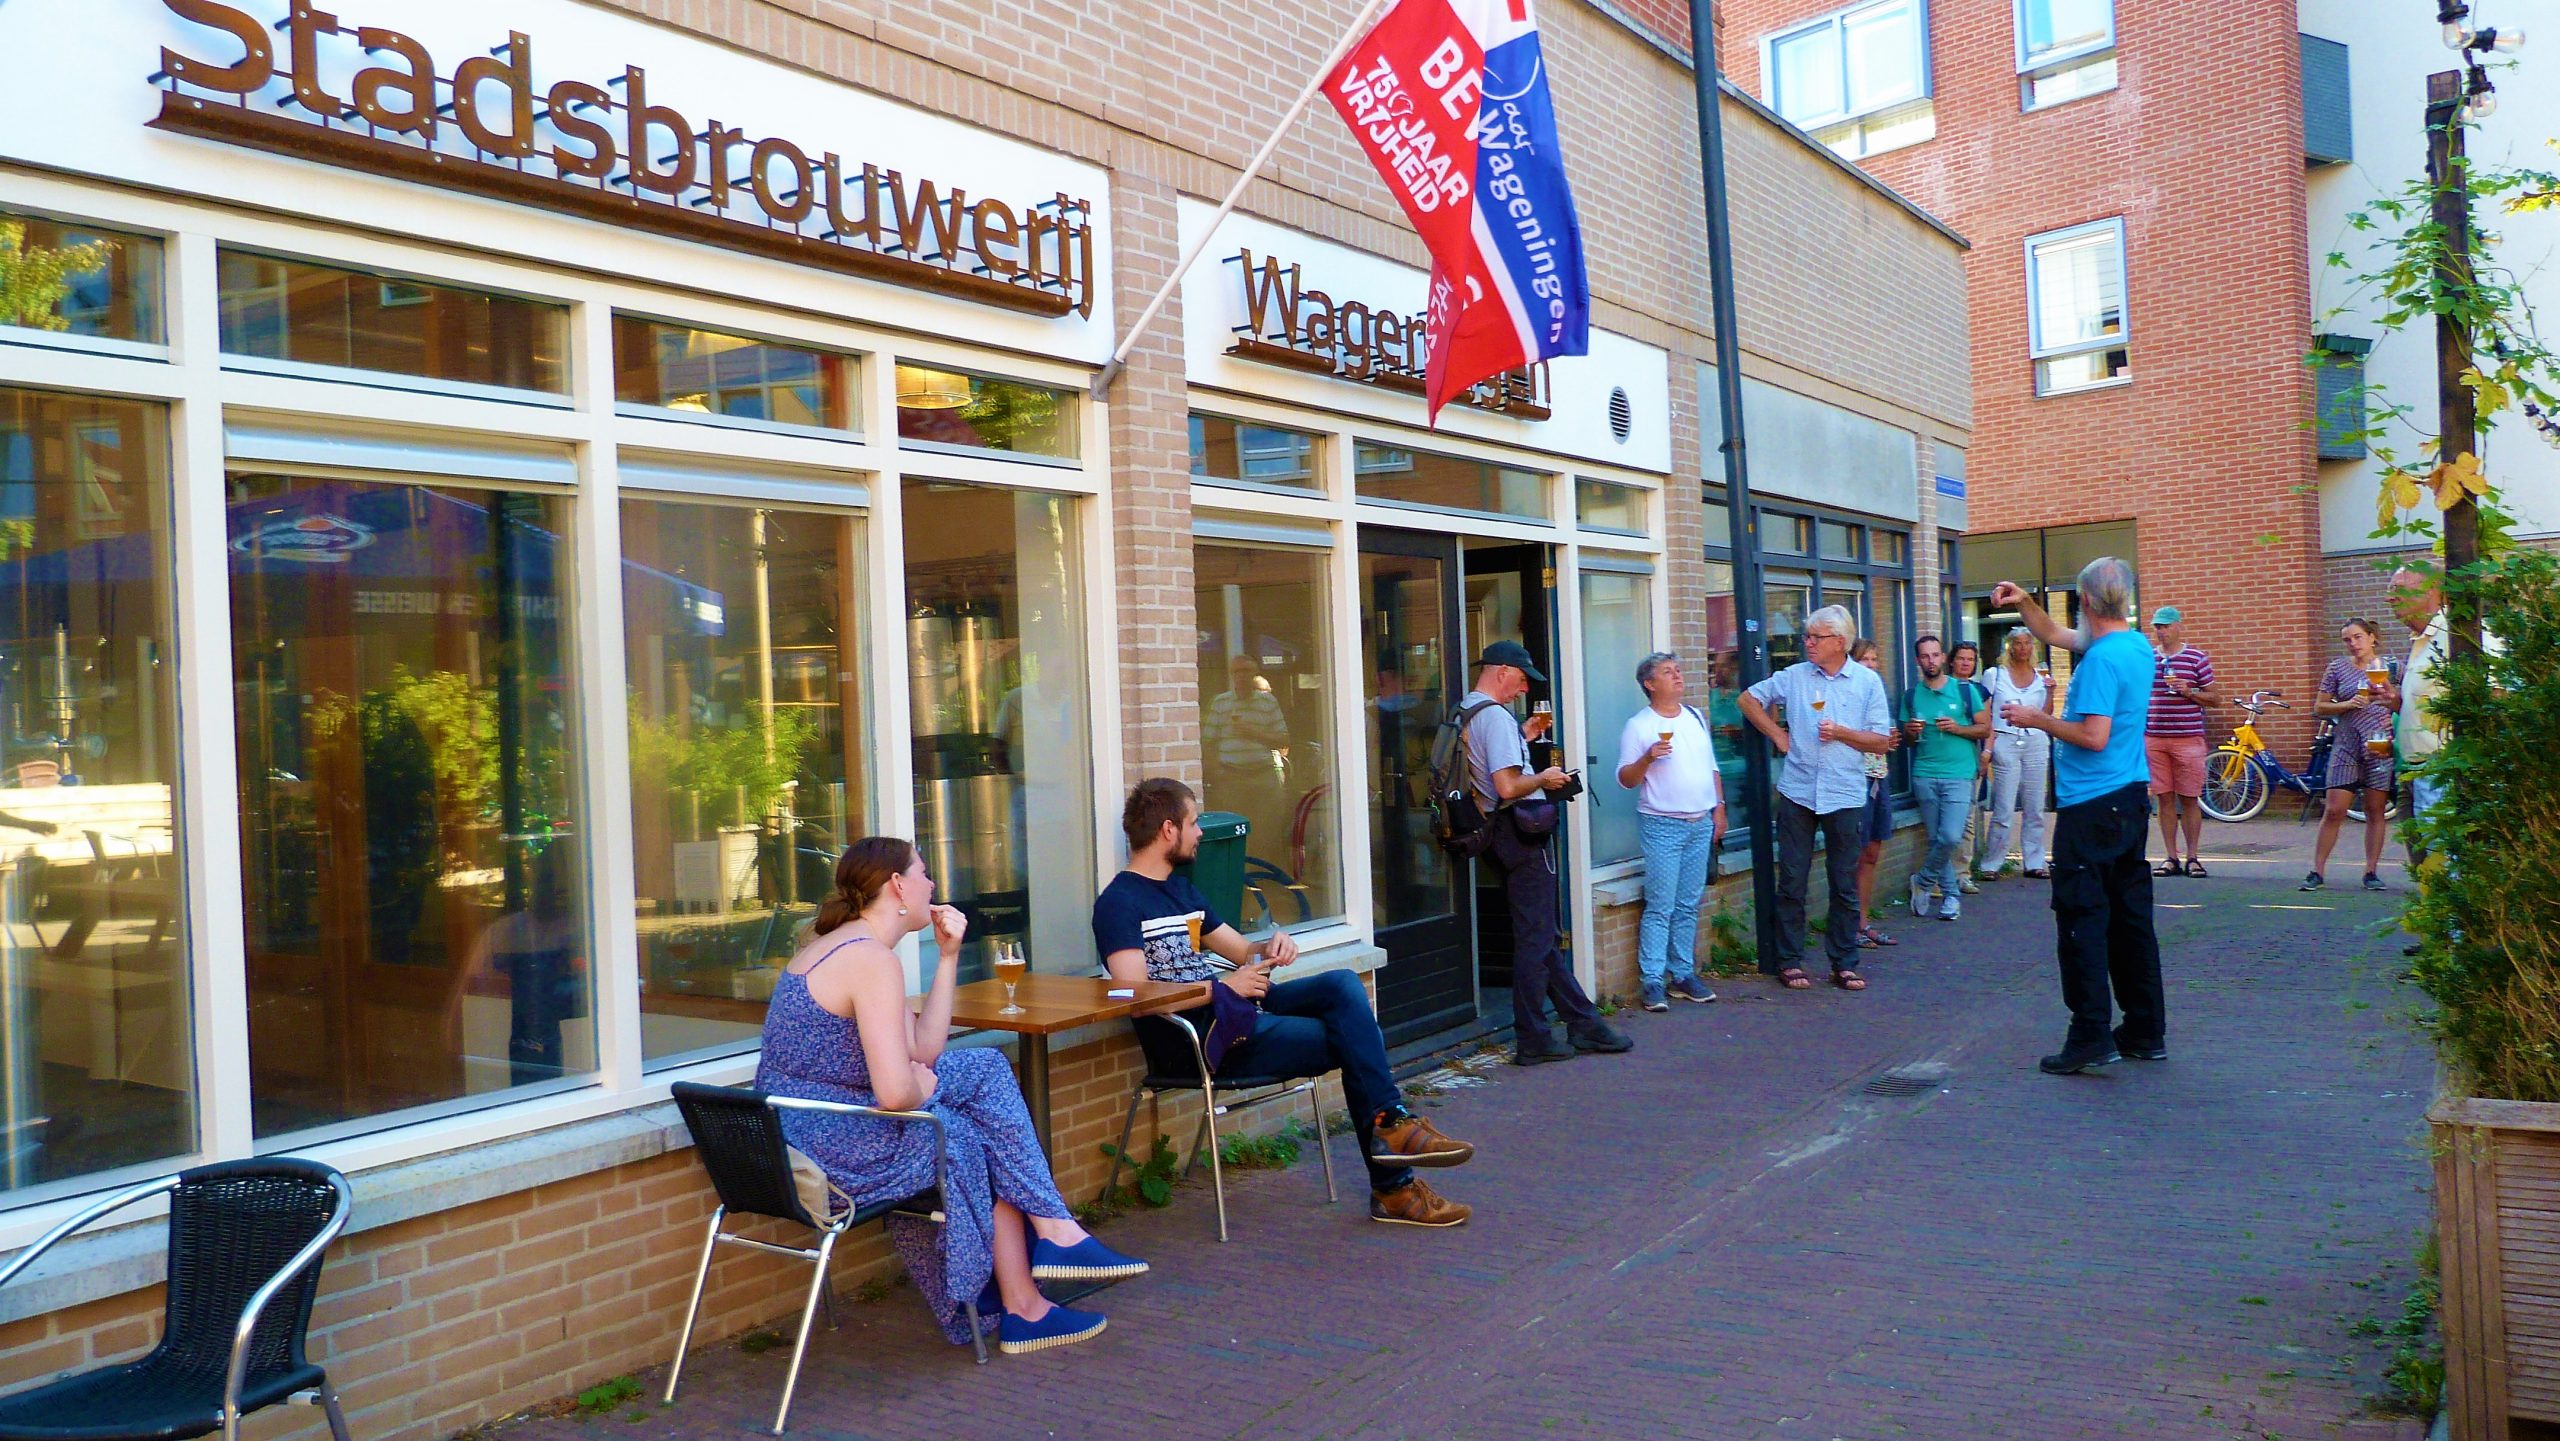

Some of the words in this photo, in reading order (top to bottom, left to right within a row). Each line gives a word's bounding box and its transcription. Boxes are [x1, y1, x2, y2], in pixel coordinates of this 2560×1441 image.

[161, 0, 1094, 321] Stadsbrouwerij
[1340, 65, 1440, 213] VRIJHEID
[1366, 56, 1400, 99] 75
[1399, 118, 1470, 207] JAAR
[1478, 108, 1566, 344] Wageningen
